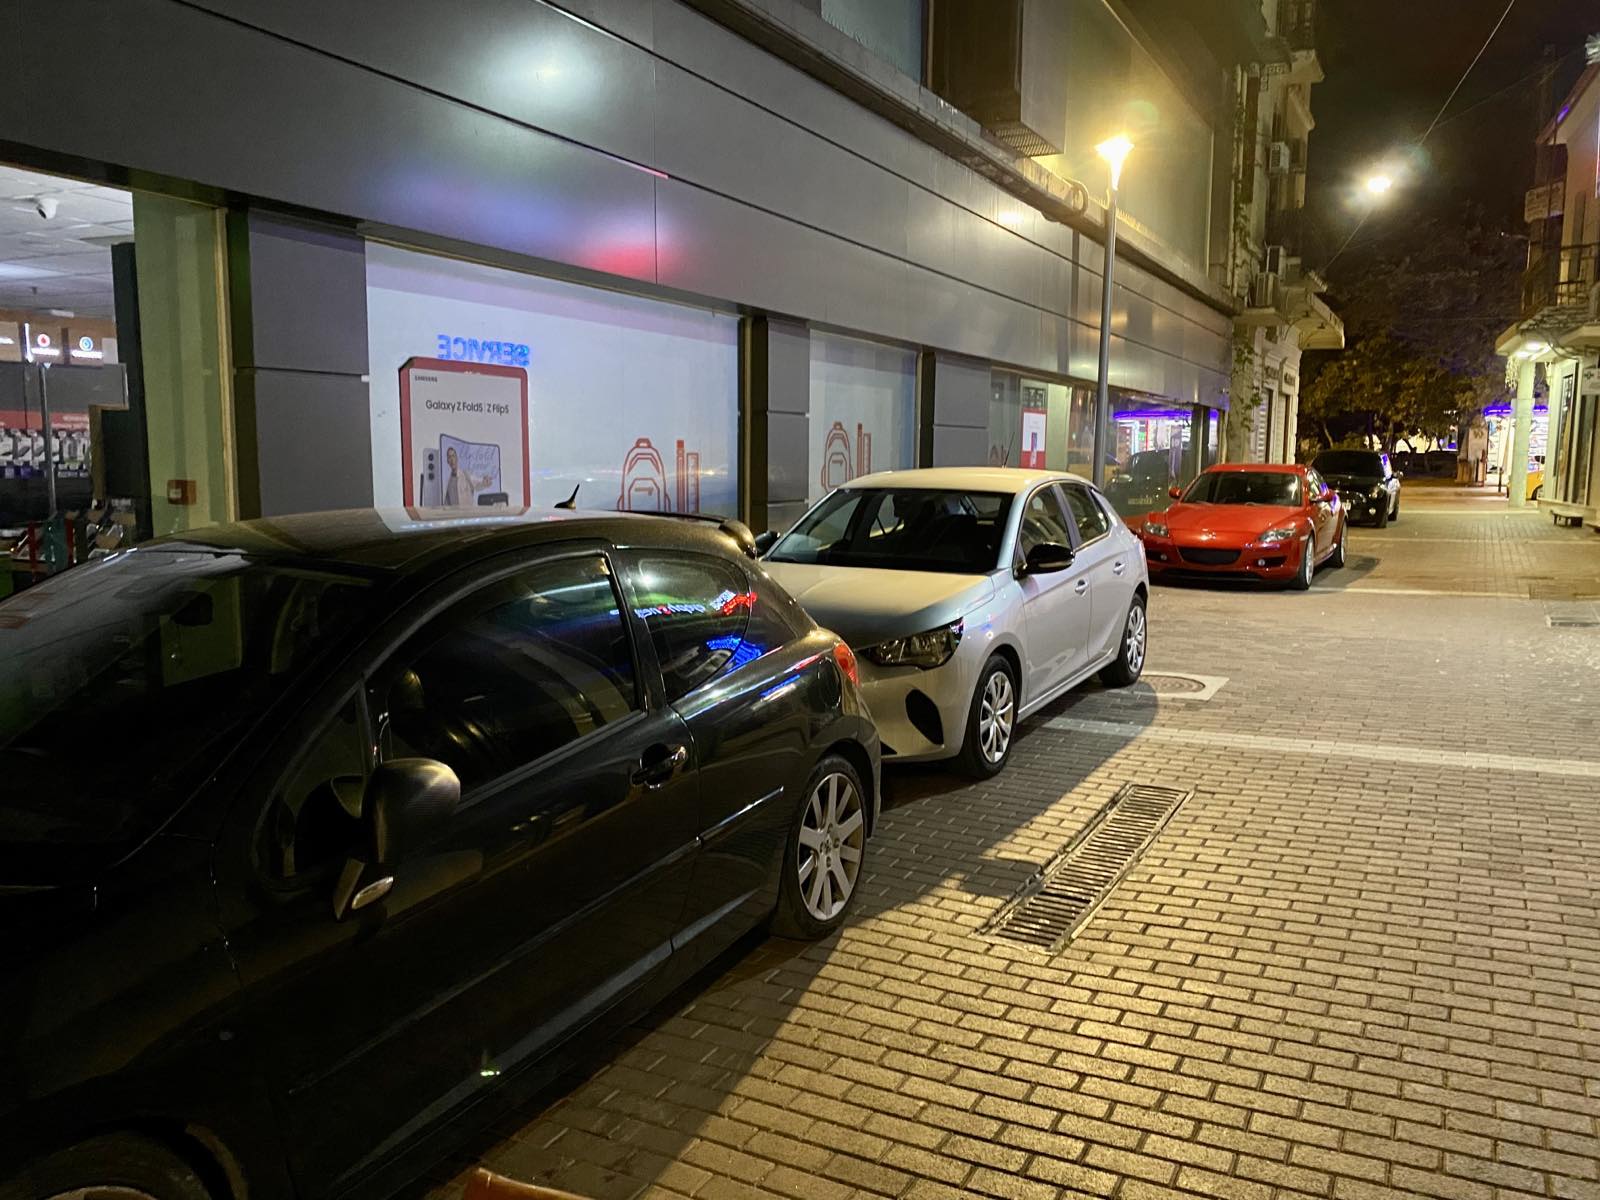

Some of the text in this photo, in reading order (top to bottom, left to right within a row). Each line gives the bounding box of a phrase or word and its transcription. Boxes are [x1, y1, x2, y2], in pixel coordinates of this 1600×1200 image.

[425, 399, 456, 413] Galaxy
[457, 401, 462, 411] Z
[463, 401, 484, 412] Fold5
[487, 403, 492, 413] Z
